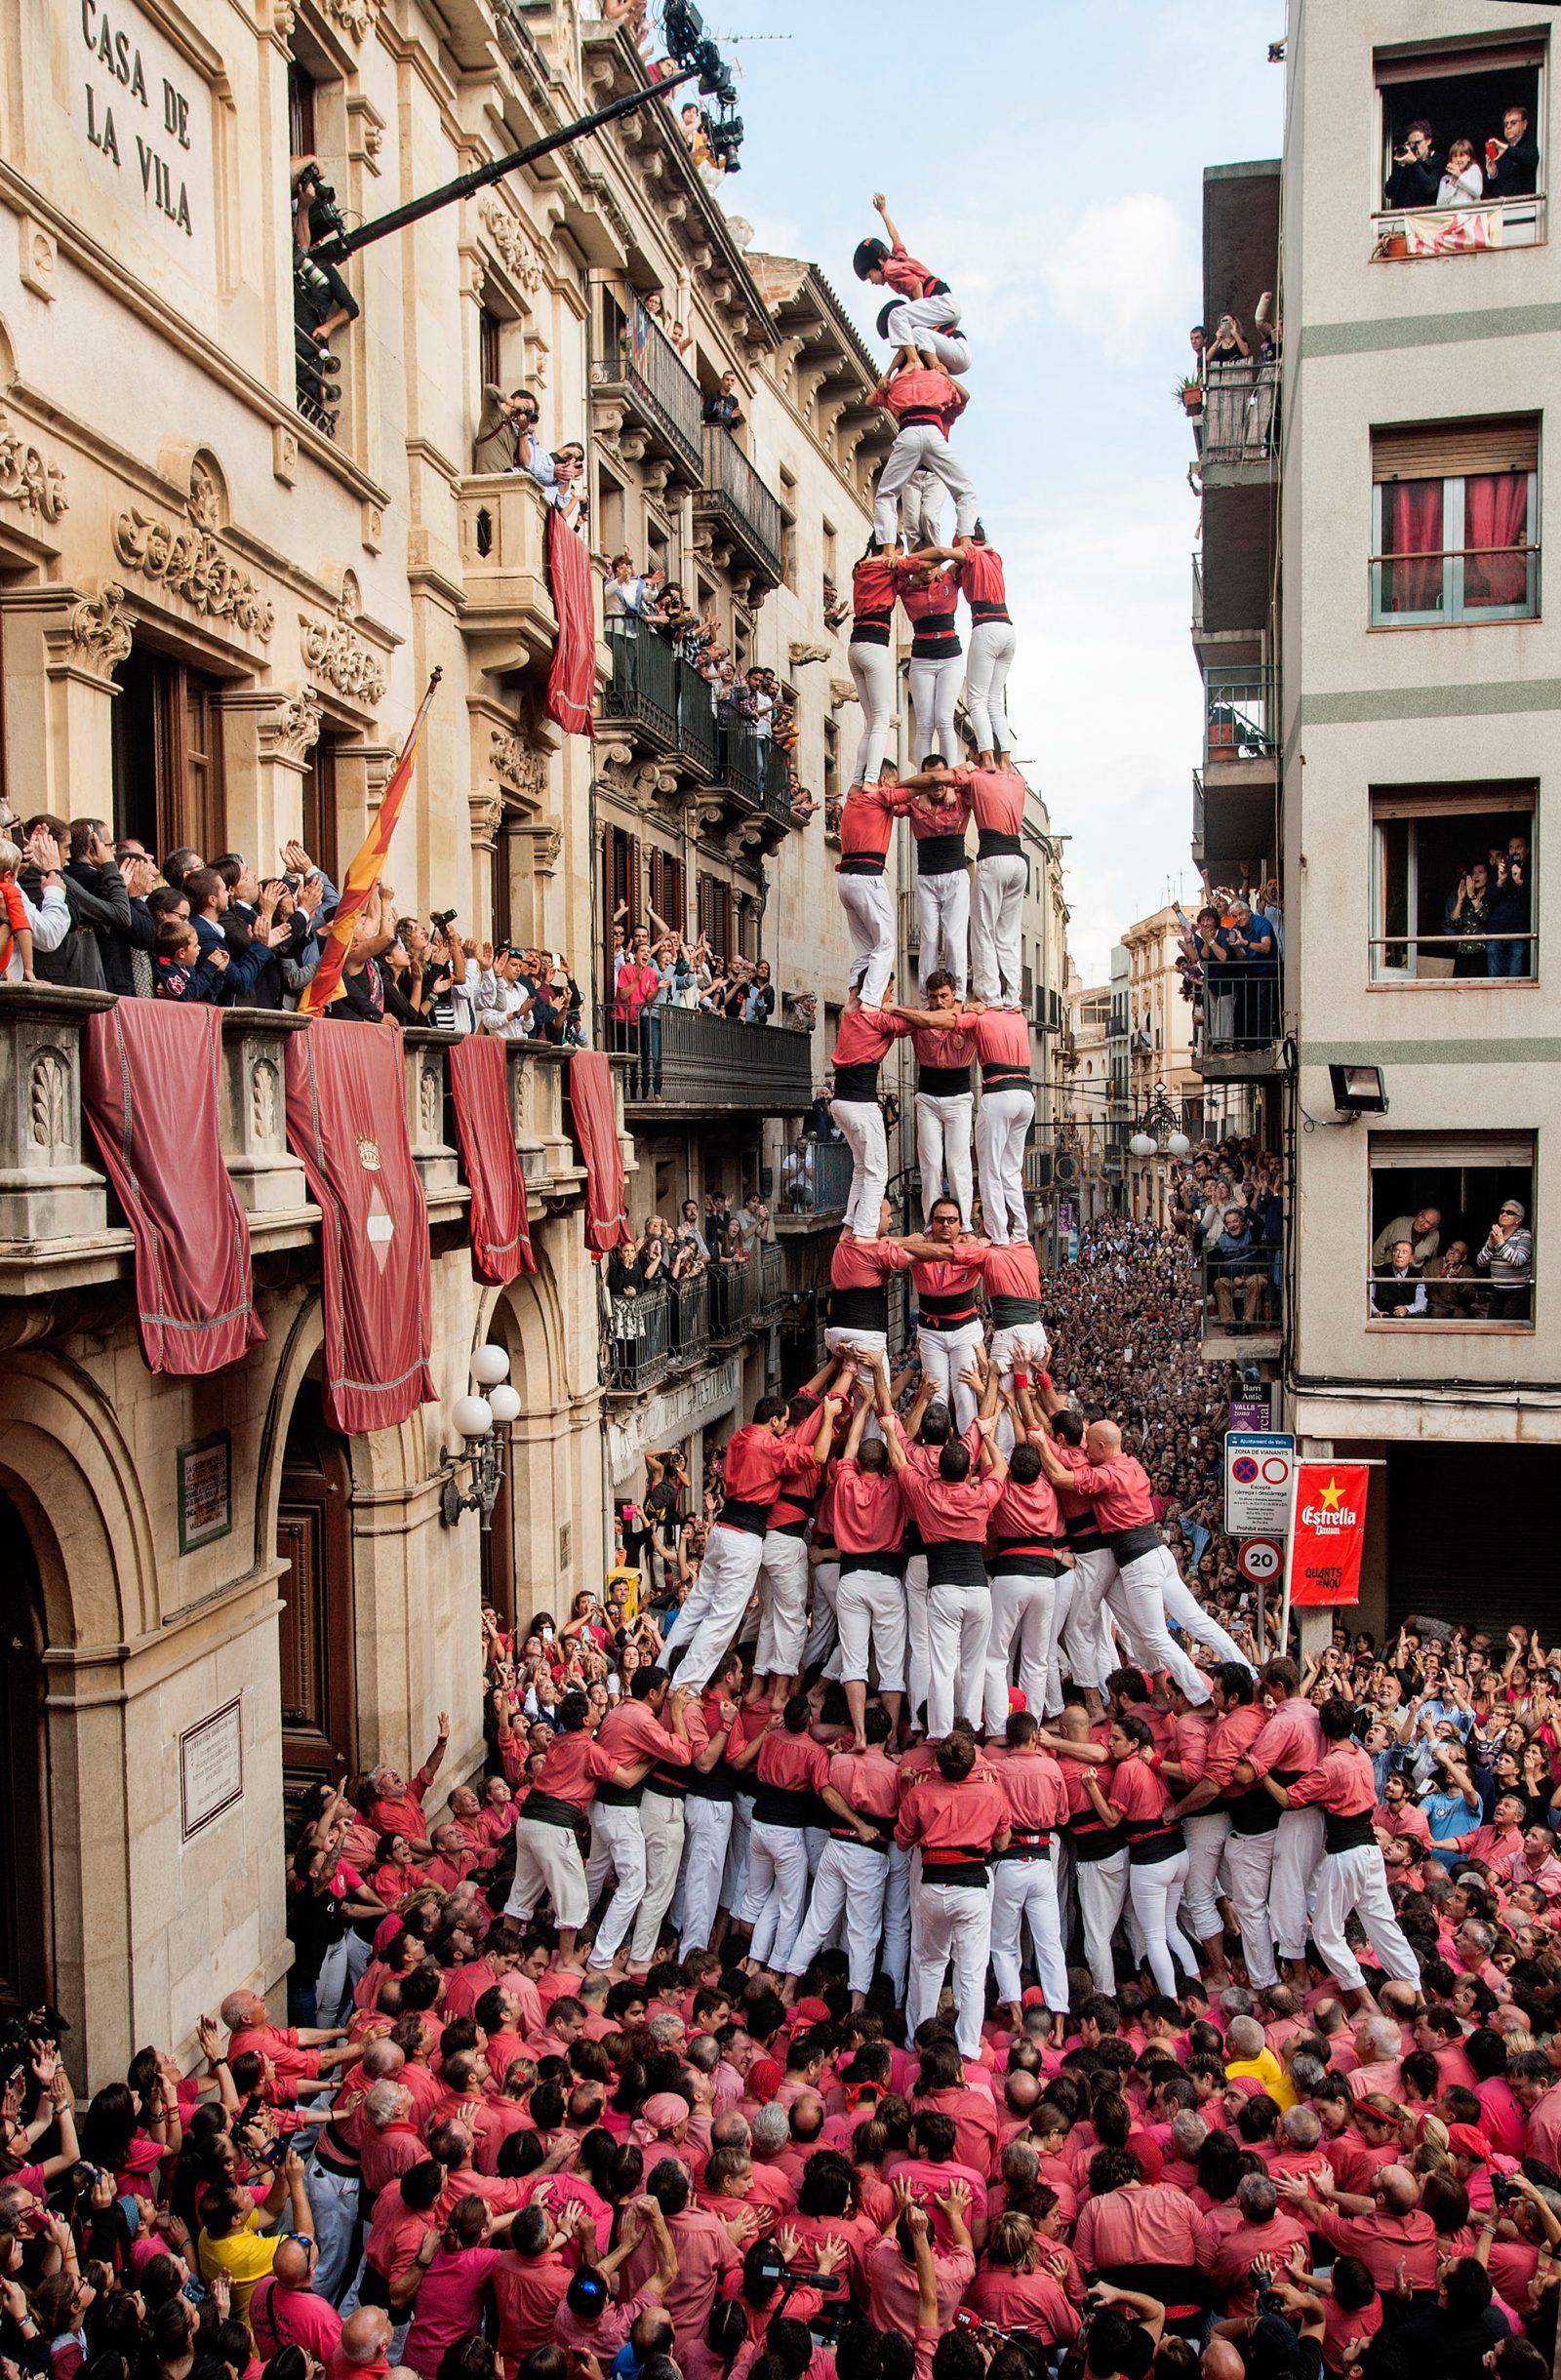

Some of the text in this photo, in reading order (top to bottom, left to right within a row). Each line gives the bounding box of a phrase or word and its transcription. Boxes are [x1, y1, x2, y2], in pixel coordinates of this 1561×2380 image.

[82, 0, 190, 150] CASA DE
[85, 83, 193, 236] LA VILA
[1301, 1504, 1356, 1527] Estrella
[1315, 1525, 1341, 1535] Damm
[1250, 1554, 1273, 1567] 20
